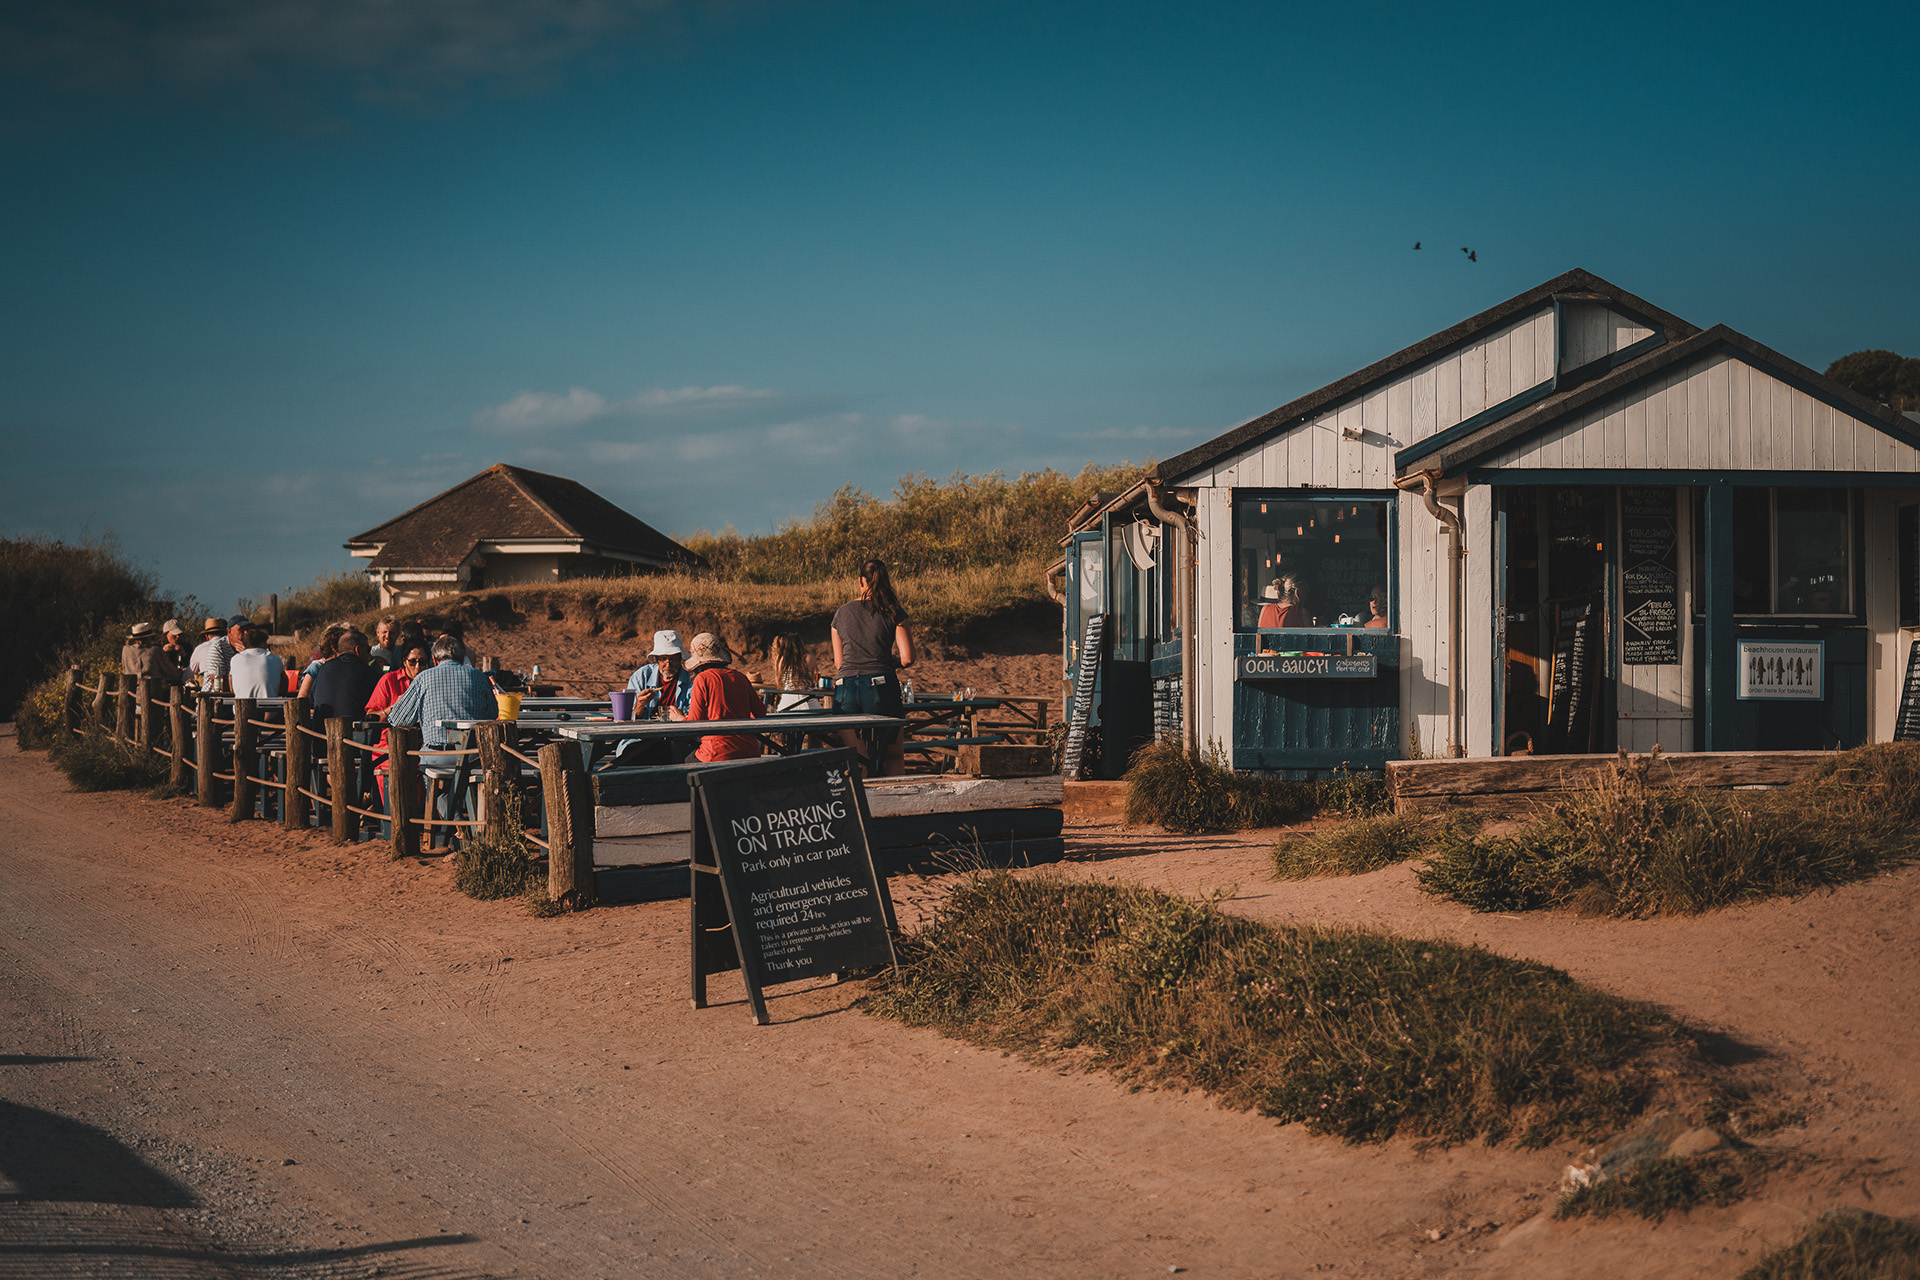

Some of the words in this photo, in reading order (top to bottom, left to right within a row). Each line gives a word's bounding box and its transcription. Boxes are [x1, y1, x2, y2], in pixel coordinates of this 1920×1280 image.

[1246, 659, 1279, 673] OOH,
[731, 816, 762, 836] NO
[767, 801, 846, 831] PARKING
[737, 834, 767, 854] ON
[771, 822, 835, 849] TRACK
[742, 858, 767, 873] Park
[769, 854, 791, 869] only
[794, 852, 804, 864] in
[806, 850, 824, 861] car
[827, 844, 850, 860] park
[750, 882, 809, 904] Agricultural
[812, 876, 852, 891] vehicles
[754, 904, 773, 916] and
[776, 894, 832, 912] emergency
[835, 888, 868, 901] access
[756, 912, 798, 930] required
[760, 934, 773, 943] This
[787, 929, 809, 939] private
[830, 920, 850, 930] action
[851, 917, 862, 925] will
[863, 915, 872, 923] be
[762, 939, 780, 950] taken
[790, 936, 813, 946] remove
[814, 933, 826, 942] any
[763, 947, 786, 959] parked
[766, 958, 794, 972] Thank
[796, 956, 812, 969] you
